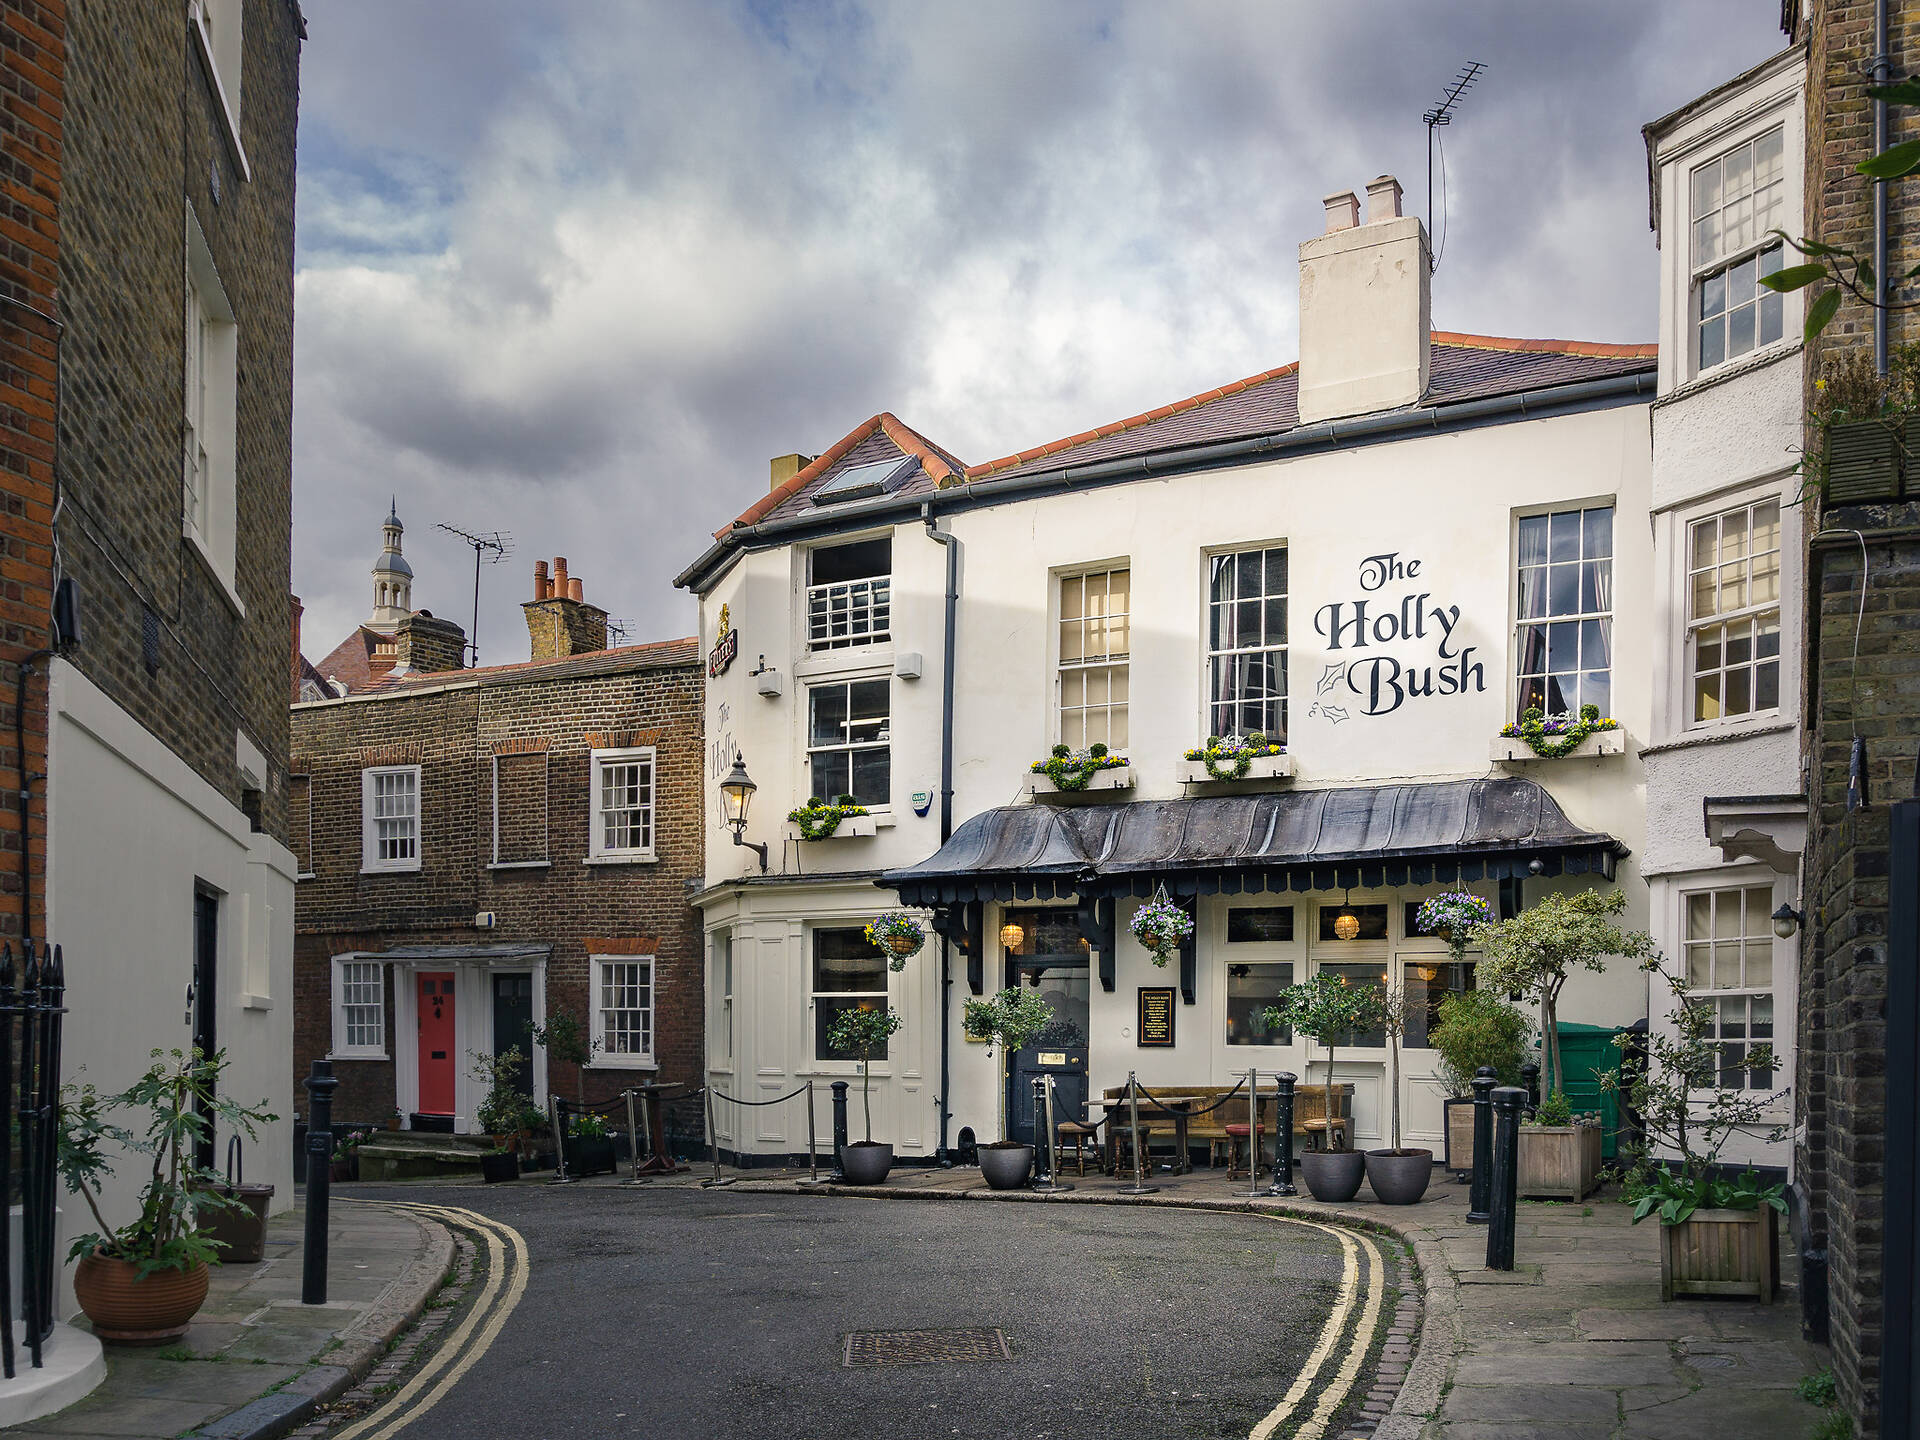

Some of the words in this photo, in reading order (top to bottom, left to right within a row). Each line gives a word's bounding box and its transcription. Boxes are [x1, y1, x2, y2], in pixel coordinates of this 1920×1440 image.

[1359, 552, 1422, 591] The
[1314, 593, 1461, 659] Holly
[1347, 647, 1487, 716] Bush
[717, 701, 730, 733] The
[710, 731, 737, 780] Holly
